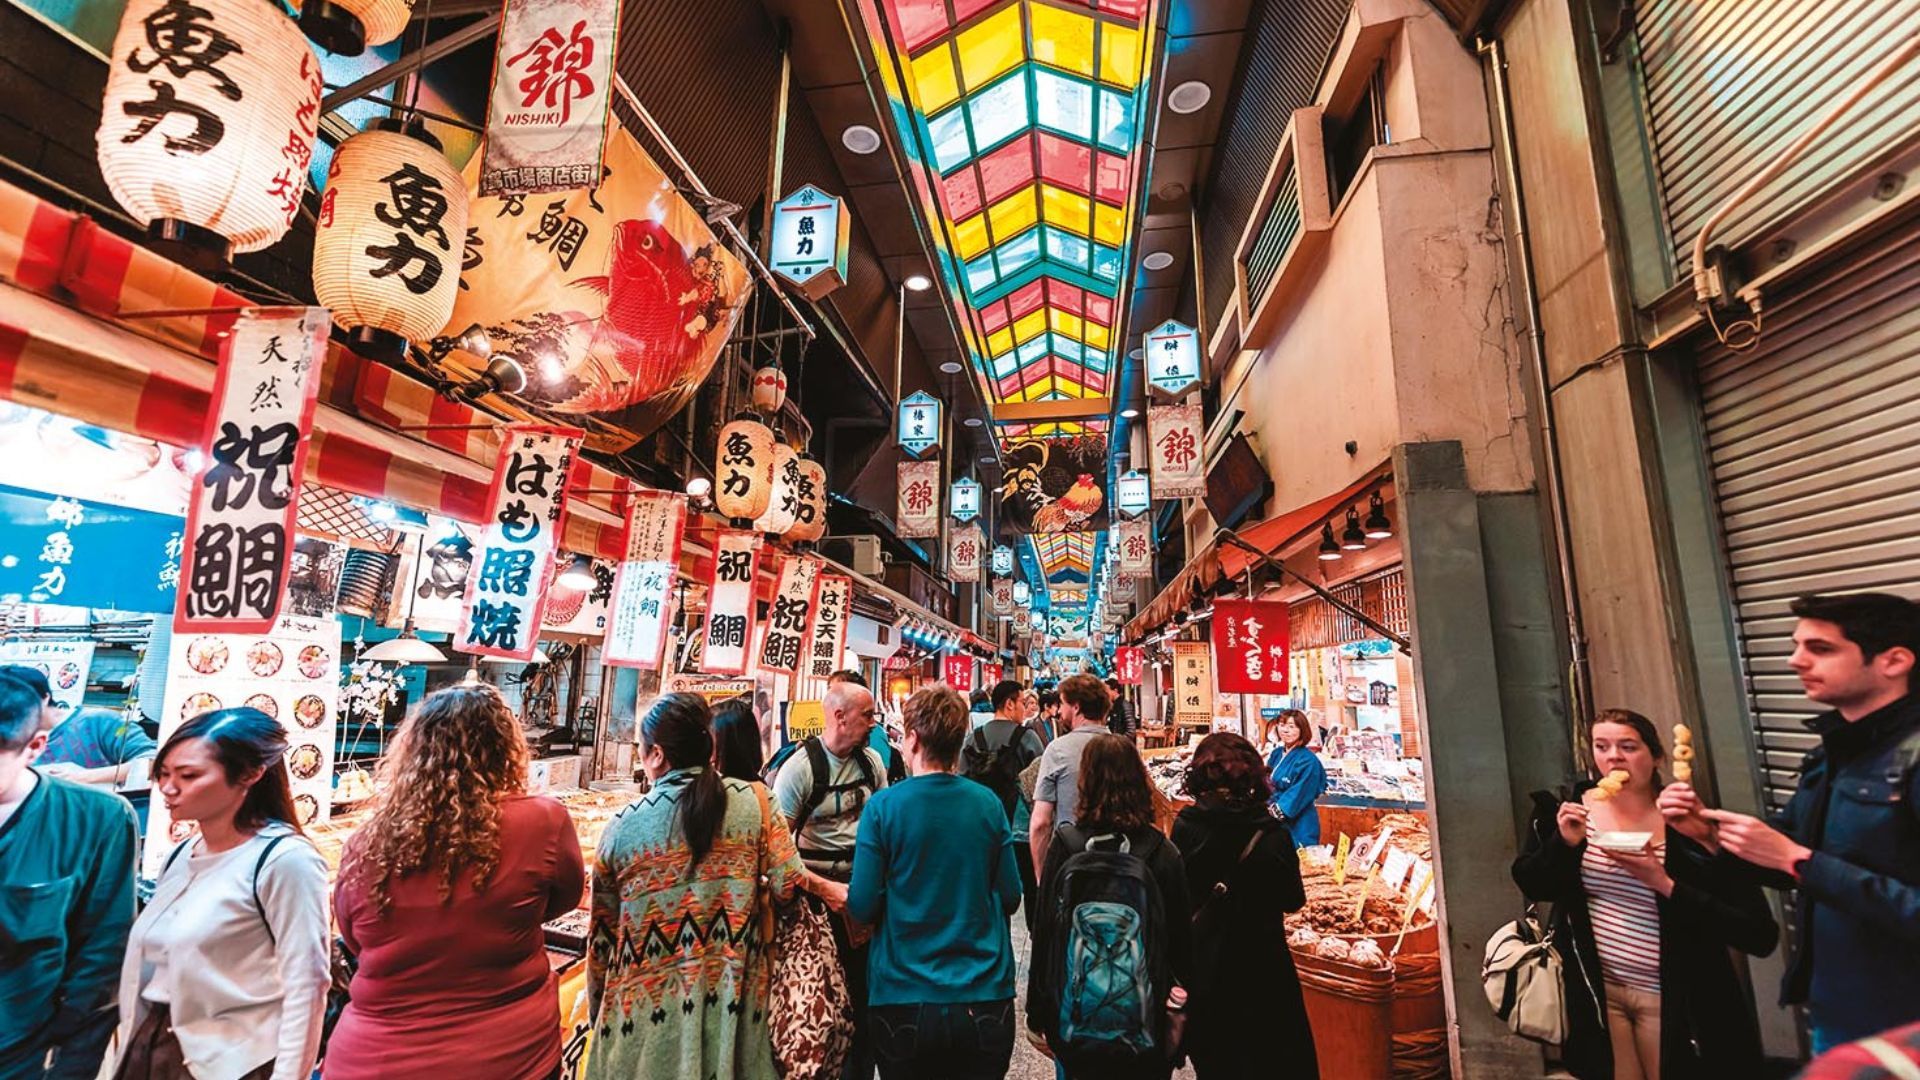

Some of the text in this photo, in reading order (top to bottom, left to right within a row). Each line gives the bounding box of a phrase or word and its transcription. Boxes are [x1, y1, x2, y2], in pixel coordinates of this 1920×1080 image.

[121, 0, 243, 156] 魚力
[506, 20, 595, 128] 錦
[504, 113, 560, 127] NISHIKI
[365, 163, 450, 295] 魚力
[796, 216, 815, 256] 魚力
[249, 335, 288, 412] 天然
[722, 432, 755, 498] 魚力
[1156, 427, 1197, 473] 錦
[187, 421, 300, 620] 祝鯛
[902, 480, 933, 516] 錦
[467, 451, 553, 651] はも照焼
[954, 540, 976, 567] 錦
[1123, 535, 1147, 562] 錦
[639, 570, 663, 619] 祝鯛
[707, 550, 752, 649] 祝鯛
[762, 594, 809, 671] 祝鯛
